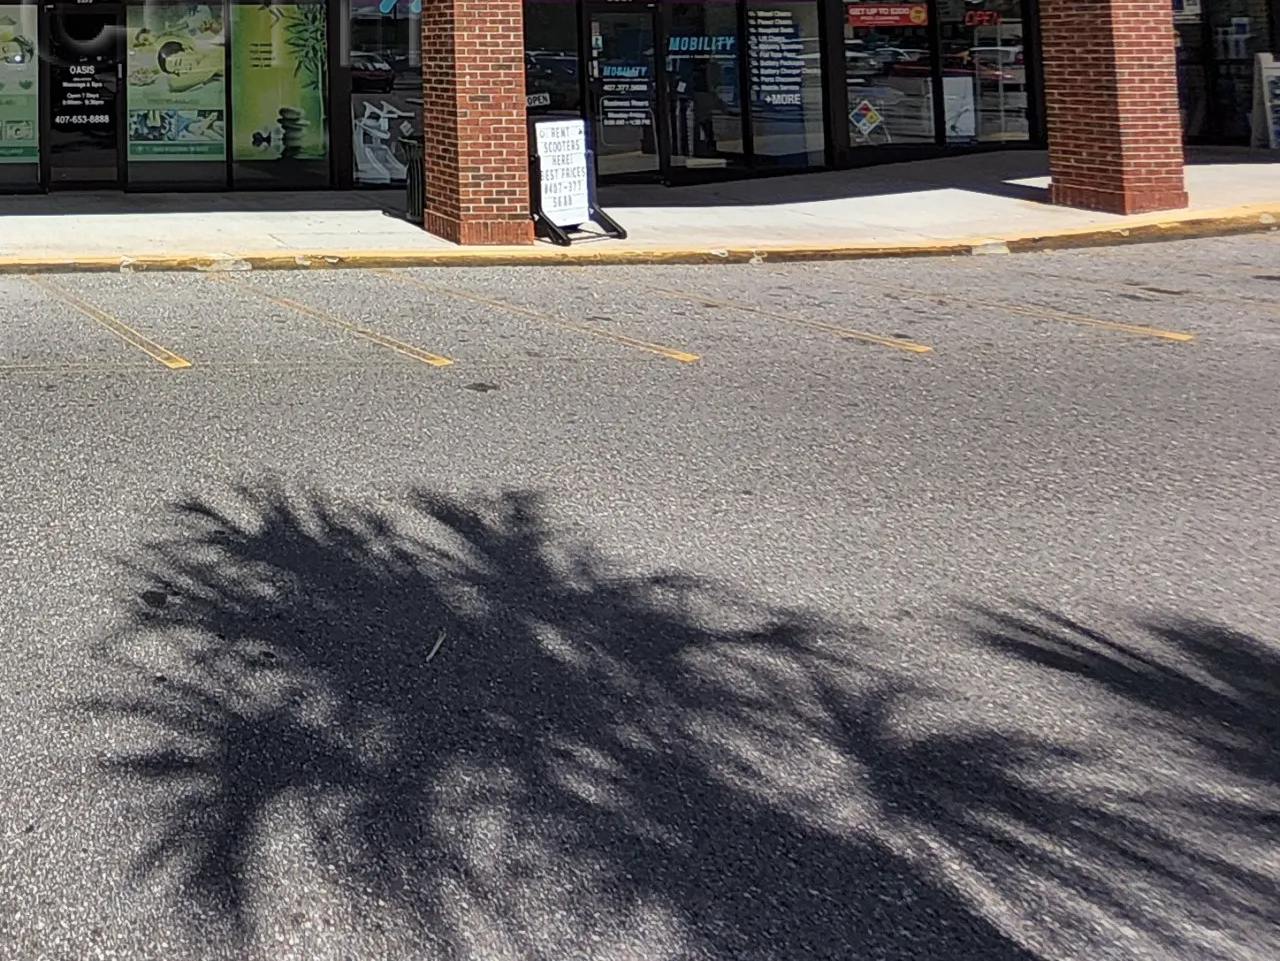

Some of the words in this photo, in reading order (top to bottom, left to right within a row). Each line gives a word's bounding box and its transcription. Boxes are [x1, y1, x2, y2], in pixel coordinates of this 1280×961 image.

[668, 36, 734, 51] MOBILITY
[70, 66, 95, 74] OASIS
[527, 96, 549, 106] OPEN
[765, 94, 801, 105] +MORE
[551, 126, 570, 138] RENT
[544, 139, 580, 153] SCOOTERS
[561, 166, 585, 179] PRICES
